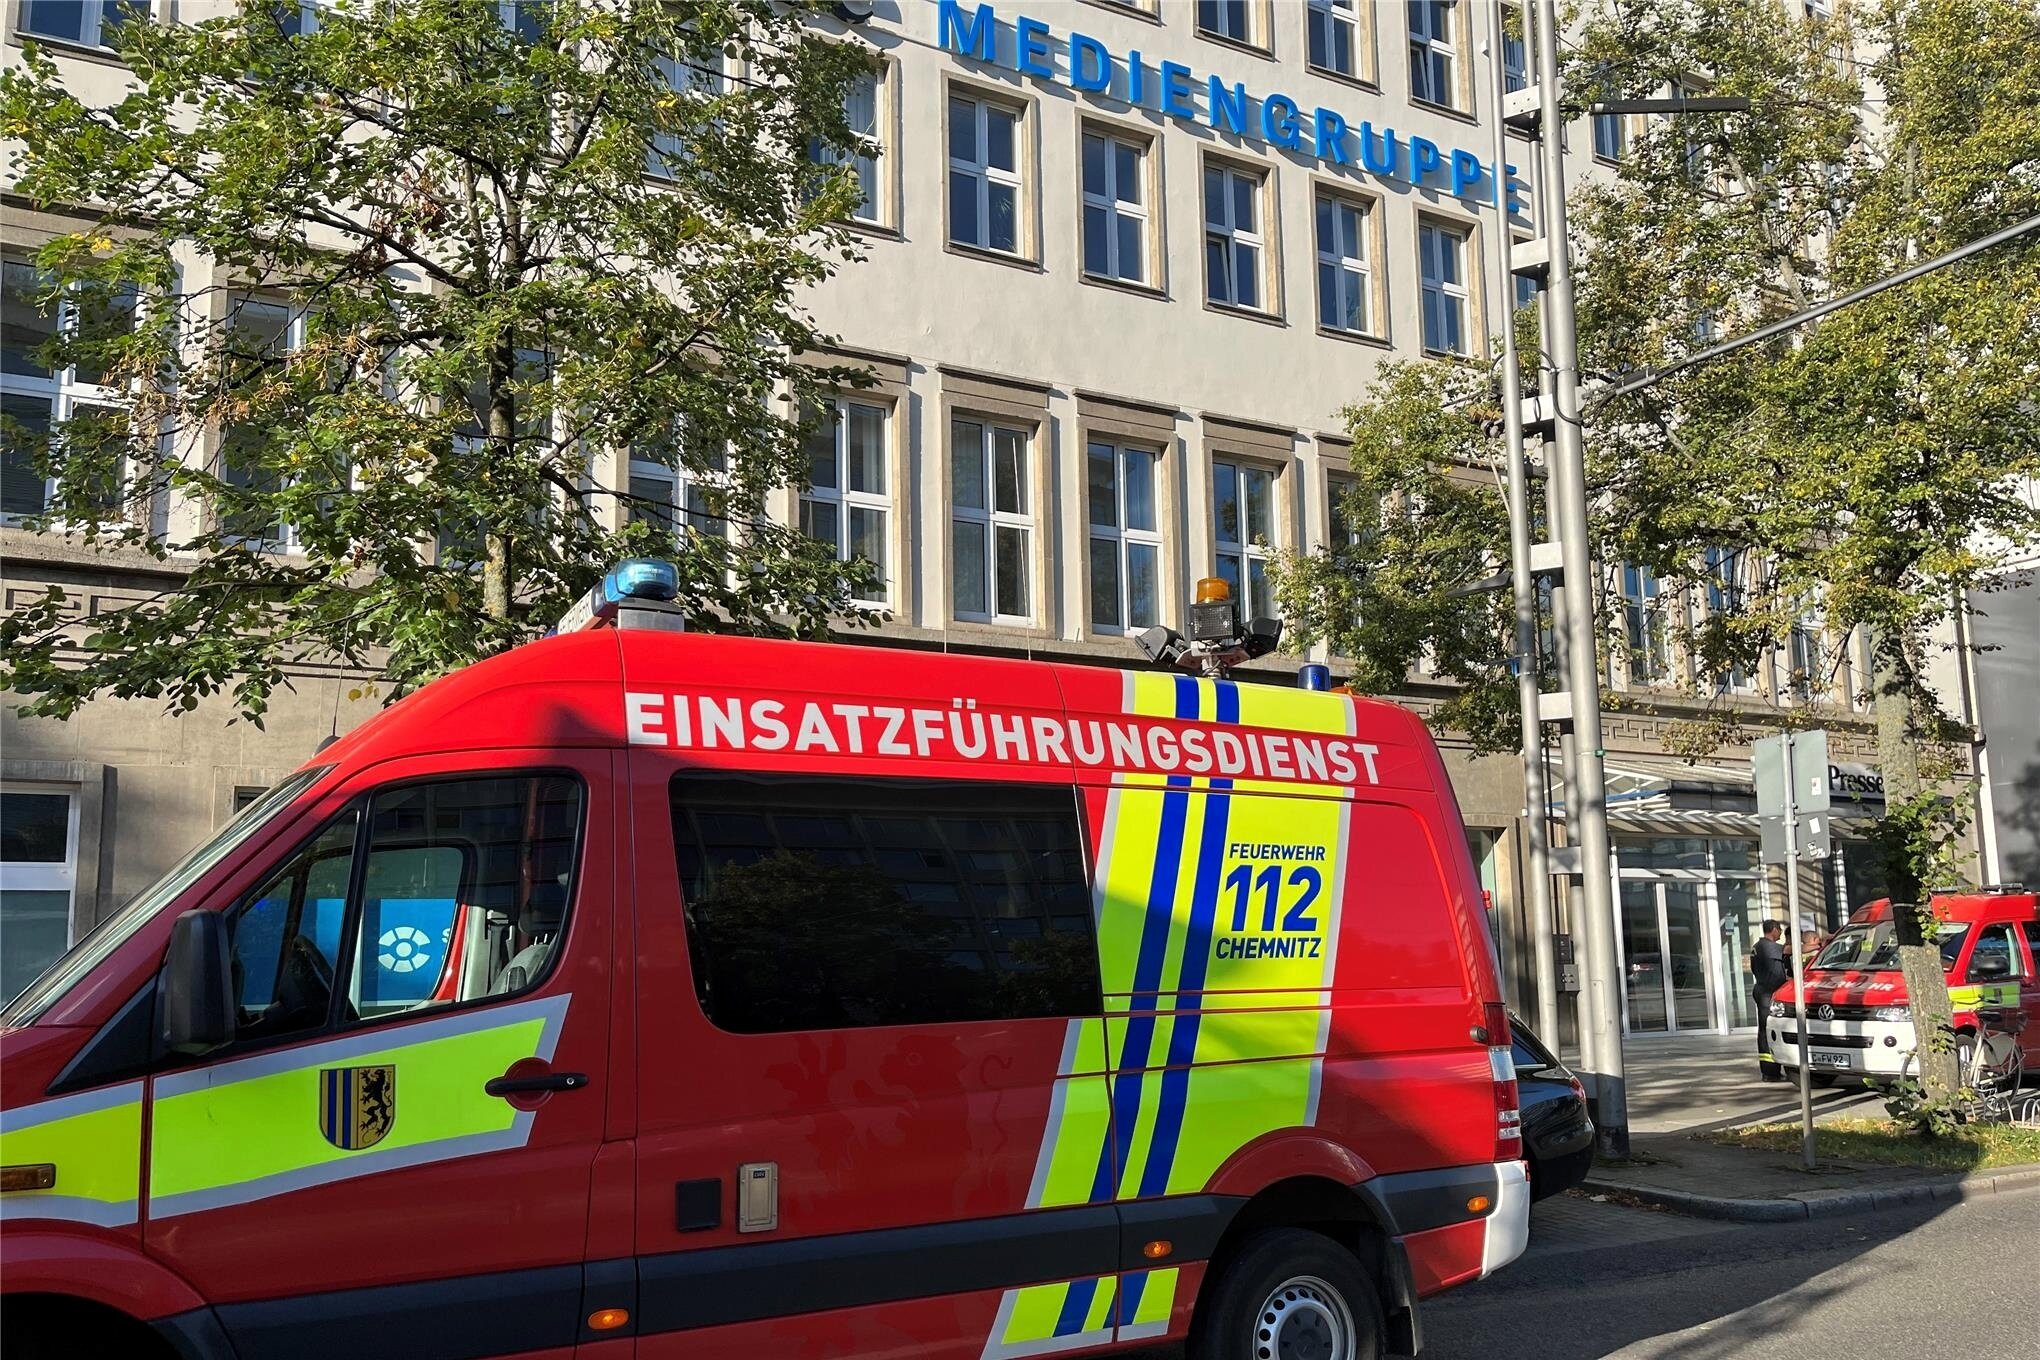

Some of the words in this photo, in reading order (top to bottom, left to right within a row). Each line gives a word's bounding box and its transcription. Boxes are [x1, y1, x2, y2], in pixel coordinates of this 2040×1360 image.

[938, 0, 1520, 213] MEDIENGRUPPE
[625, 692, 1379, 784] EINSATZFÜHRUNGSDIENST
[1828, 764, 1885, 793] Presse
[1229, 843, 1326, 861] FEUERWEHR
[1225, 865, 1322, 931] 112
[1216, 937, 1322, 959] CHEMNITZ
